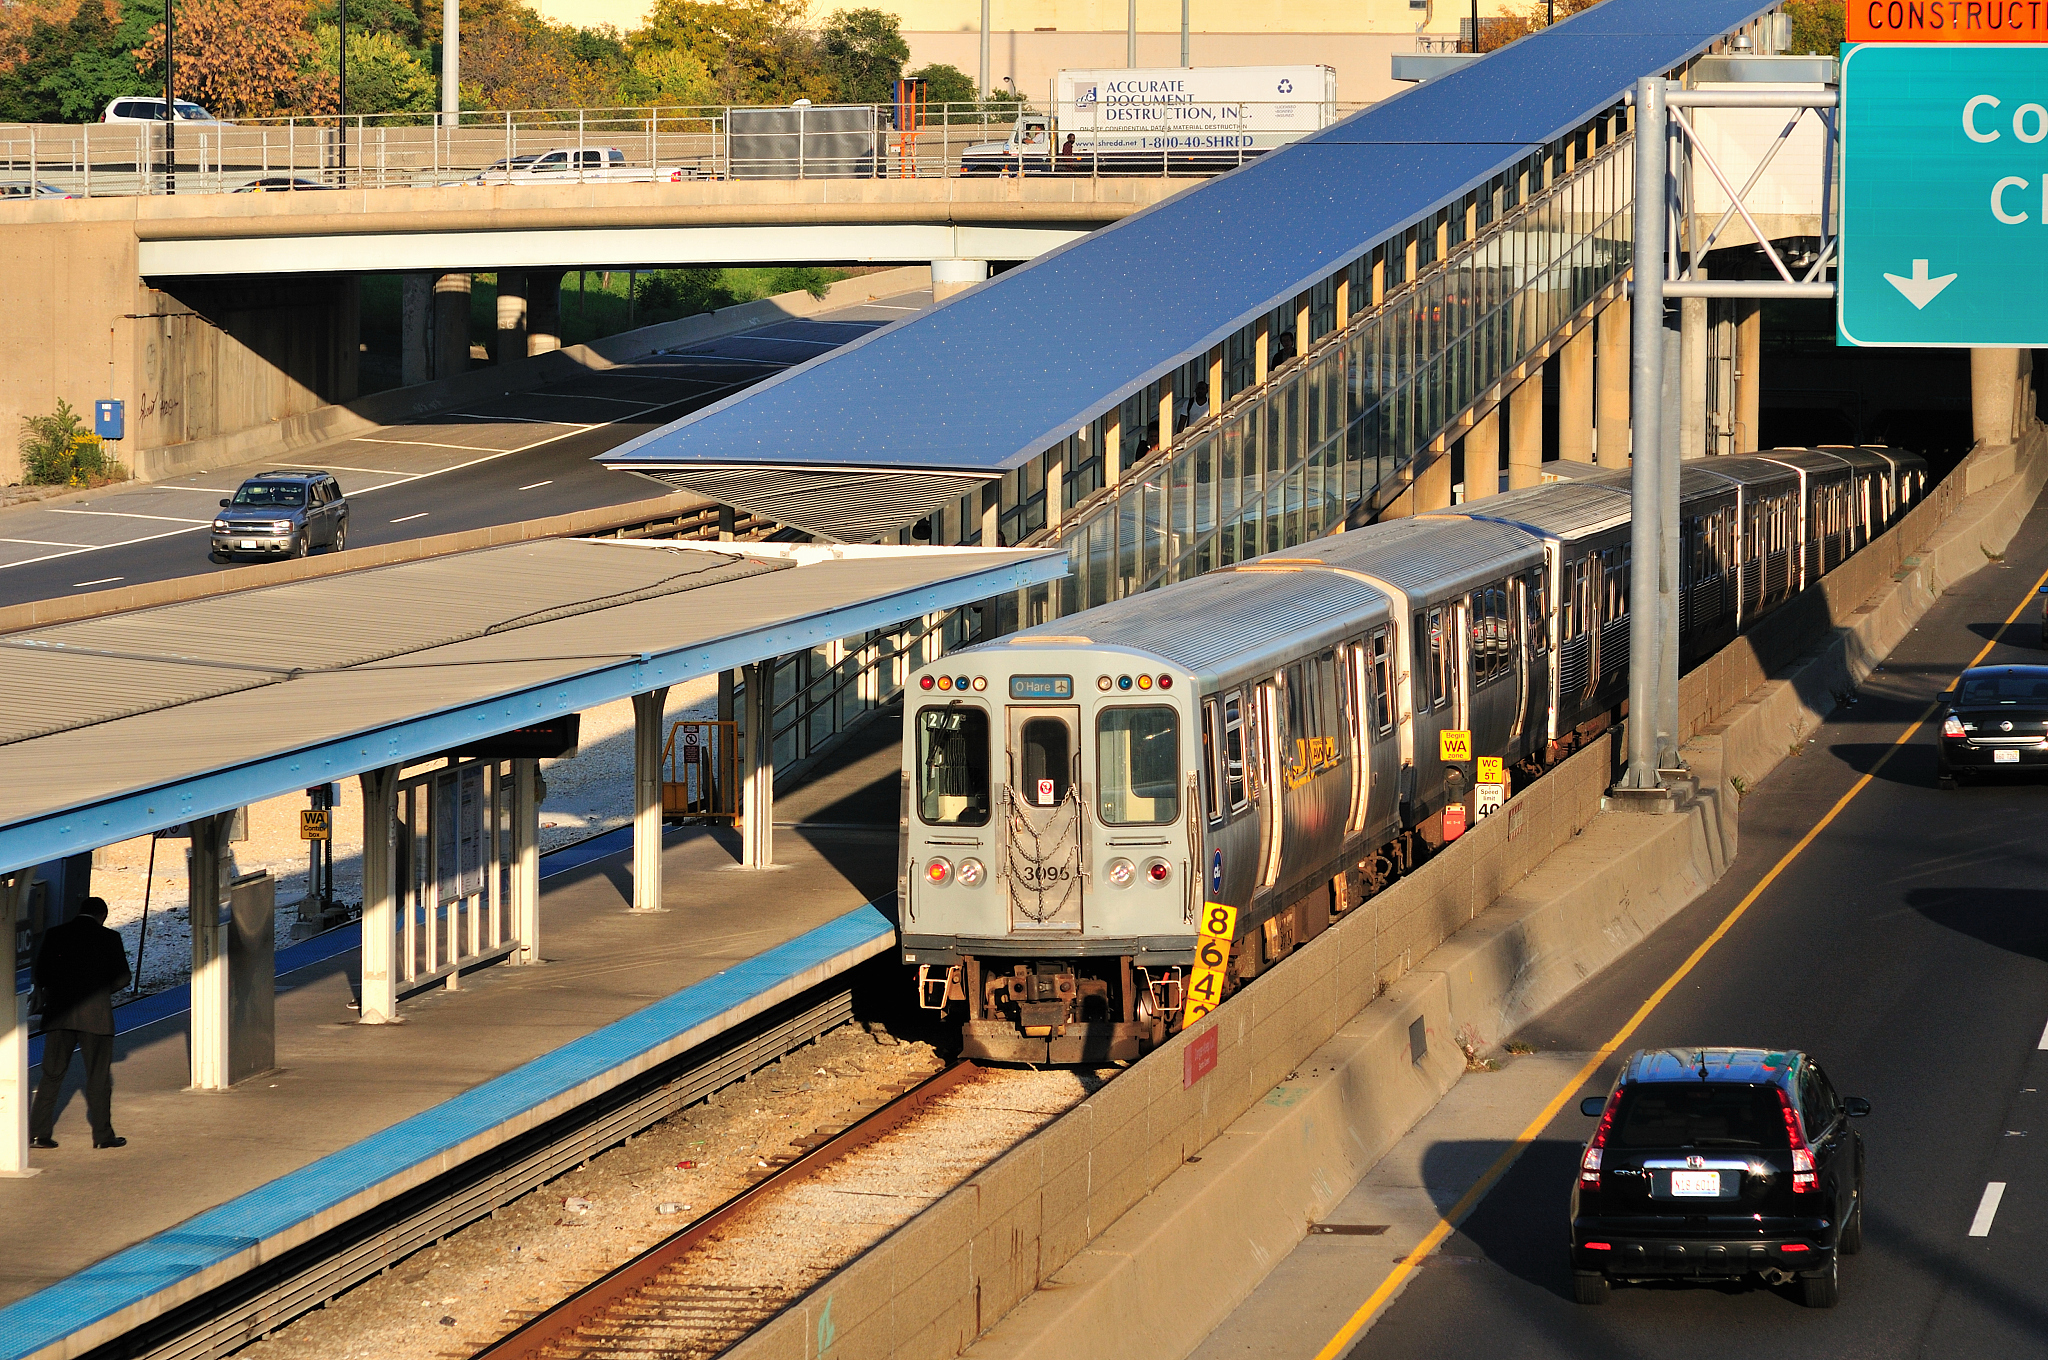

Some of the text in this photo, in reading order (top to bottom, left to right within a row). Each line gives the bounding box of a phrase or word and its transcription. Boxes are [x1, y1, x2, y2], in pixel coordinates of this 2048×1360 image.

[1868, 1, 2048, 30] CONSTRUCT
[1105, 80, 1185, 93] ACCURATE
[1105, 94, 1195, 107] DOCUMENT
[1105, 106, 1252, 121] DESTRUCTION, INC.
[1140, 135, 1254, 148] 1-800-40-SHRED
[1015, 681, 1051, 692] O'Hare
[1445, 732, 1465, 740] Begin
[1443, 740, 1468, 753] WA
[1482, 759, 1498, 768] WC
[1484, 772, 1496, 780] 5T
[1480, 788, 1499, 796] Speed
[303, 812, 325, 824] WA
[1207, 908, 1229, 935] 8
[16, 928, 31, 954] UIC
[1200, 941, 1223, 968] 6
[1194, 973, 1216, 1001] 4
